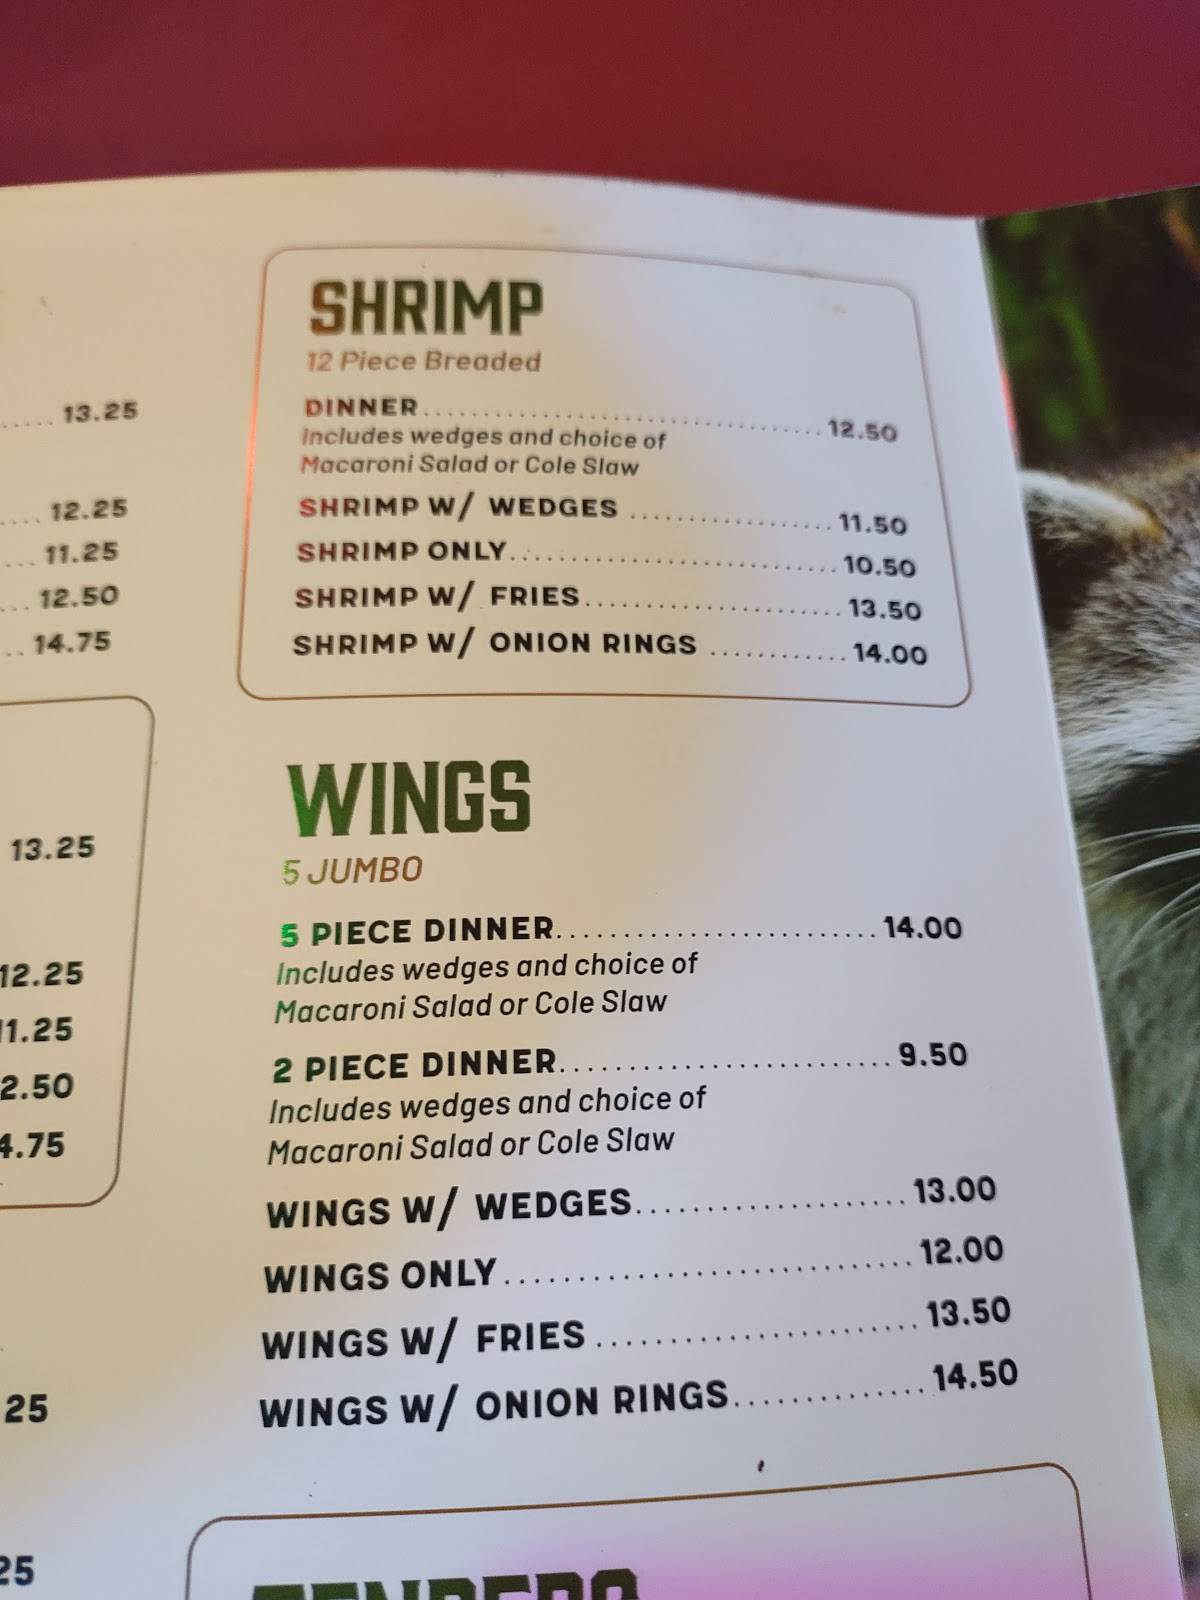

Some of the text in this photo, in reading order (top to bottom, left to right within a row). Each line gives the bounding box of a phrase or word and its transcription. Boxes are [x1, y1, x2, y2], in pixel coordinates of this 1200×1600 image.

[310, 278, 543, 336] SHRIMP
[309, 350, 541, 372] 12 Piece Breaded
[63, 400, 138, 424] 13.25
[305, 396, 898, 443] DINNER 12.50
[302, 426, 667, 450] Includes wedges and choice of
[301, 454, 639, 476] Macaroni Salad or Cole Slaw
[51, 497, 128, 522] 12.25
[299, 490, 908, 536] SHRIMP W/ WEDGES 11.50
[45, 540, 119, 565] 11.25
[297, 541, 917, 578] SHRIMP ONLY 10.50
[40, 584, 120, 609] 12.50
[295, 580, 922, 621] SHRIMP W/ FRIES 13.50
[34, 630, 111, 655] 14.75
[293, 626, 928, 666] SHRIMP W/ ONION RINGS 14.00
[286, 760, 531, 837] WINGS
[11, 835, 95, 861] 13.25
[283, 856, 422, 885] 5 JUMBO
[280, 916, 963, 947] 5 PIECE DINNER 14.00
[0, 961, 84, 988] 12.25
[277, 952, 699, 985] Includes wedges and choice of
[274, 989, 668, 1024] Macaroni Salad or Cole Slaw
[273, 1042, 968, 1084] 2 PIECE DINNER 9.50
[269, 1085, 708, 1124] Includes wedges and choice of
[267, 1127, 675, 1165] Macaroni Salad or Cole Slaw
[266, 1175, 997, 1232] WINGS W/ WEDGES 13.00
[264, 1234, 1004, 1294] WINGS ONLY 12.00
[261, 1295, 1011, 1364] WINGS W/ FRIES 13.50
[259, 1358, 1018, 1432] WINGS W/ ONION RINGS 14.50
